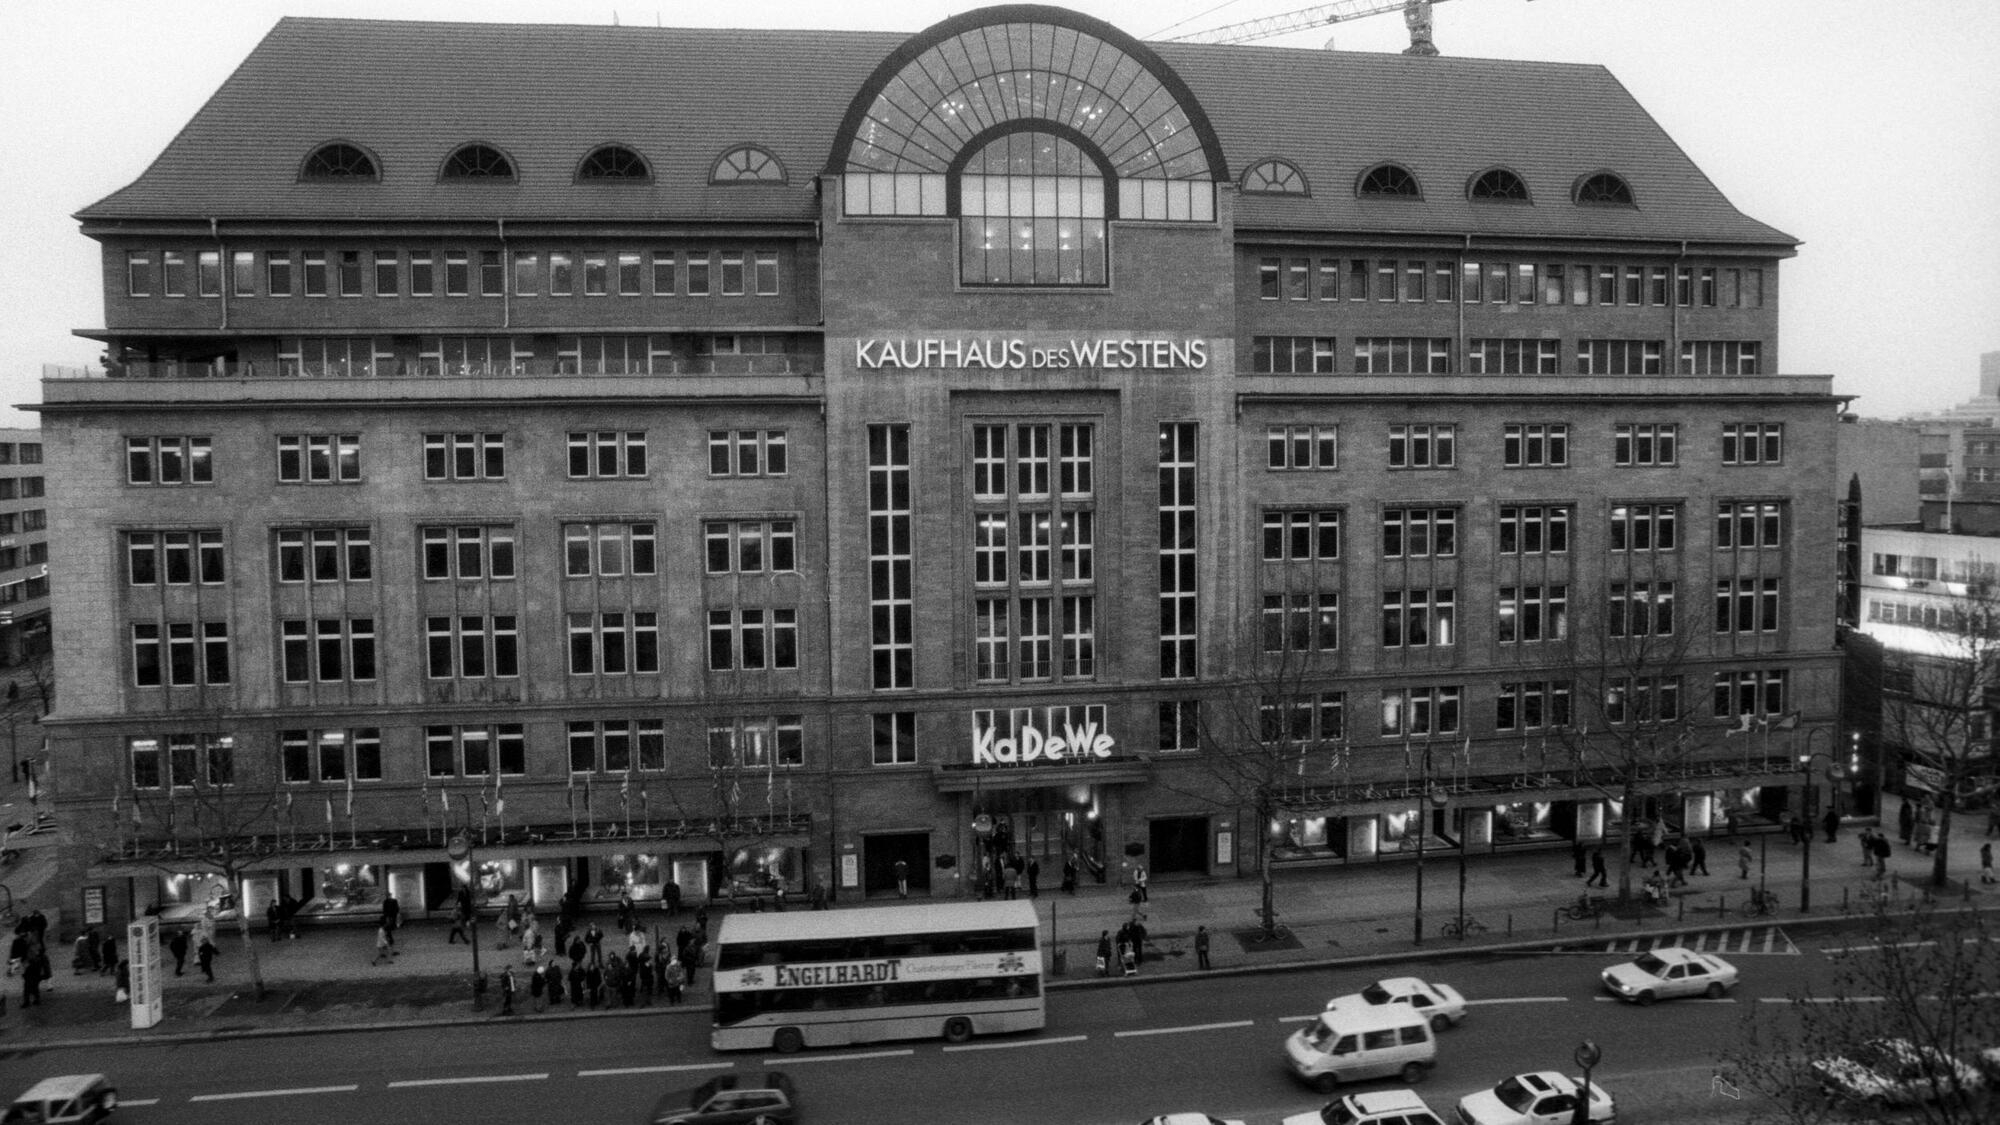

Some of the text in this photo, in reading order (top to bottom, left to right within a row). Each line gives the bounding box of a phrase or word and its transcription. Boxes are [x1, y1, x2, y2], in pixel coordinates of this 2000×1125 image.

[855, 338, 1207, 369] KAUFHAUS DES WESTENS
[973, 721, 1115, 764] KaDeWe
[775, 959, 901, 987] ENGELHARDT
